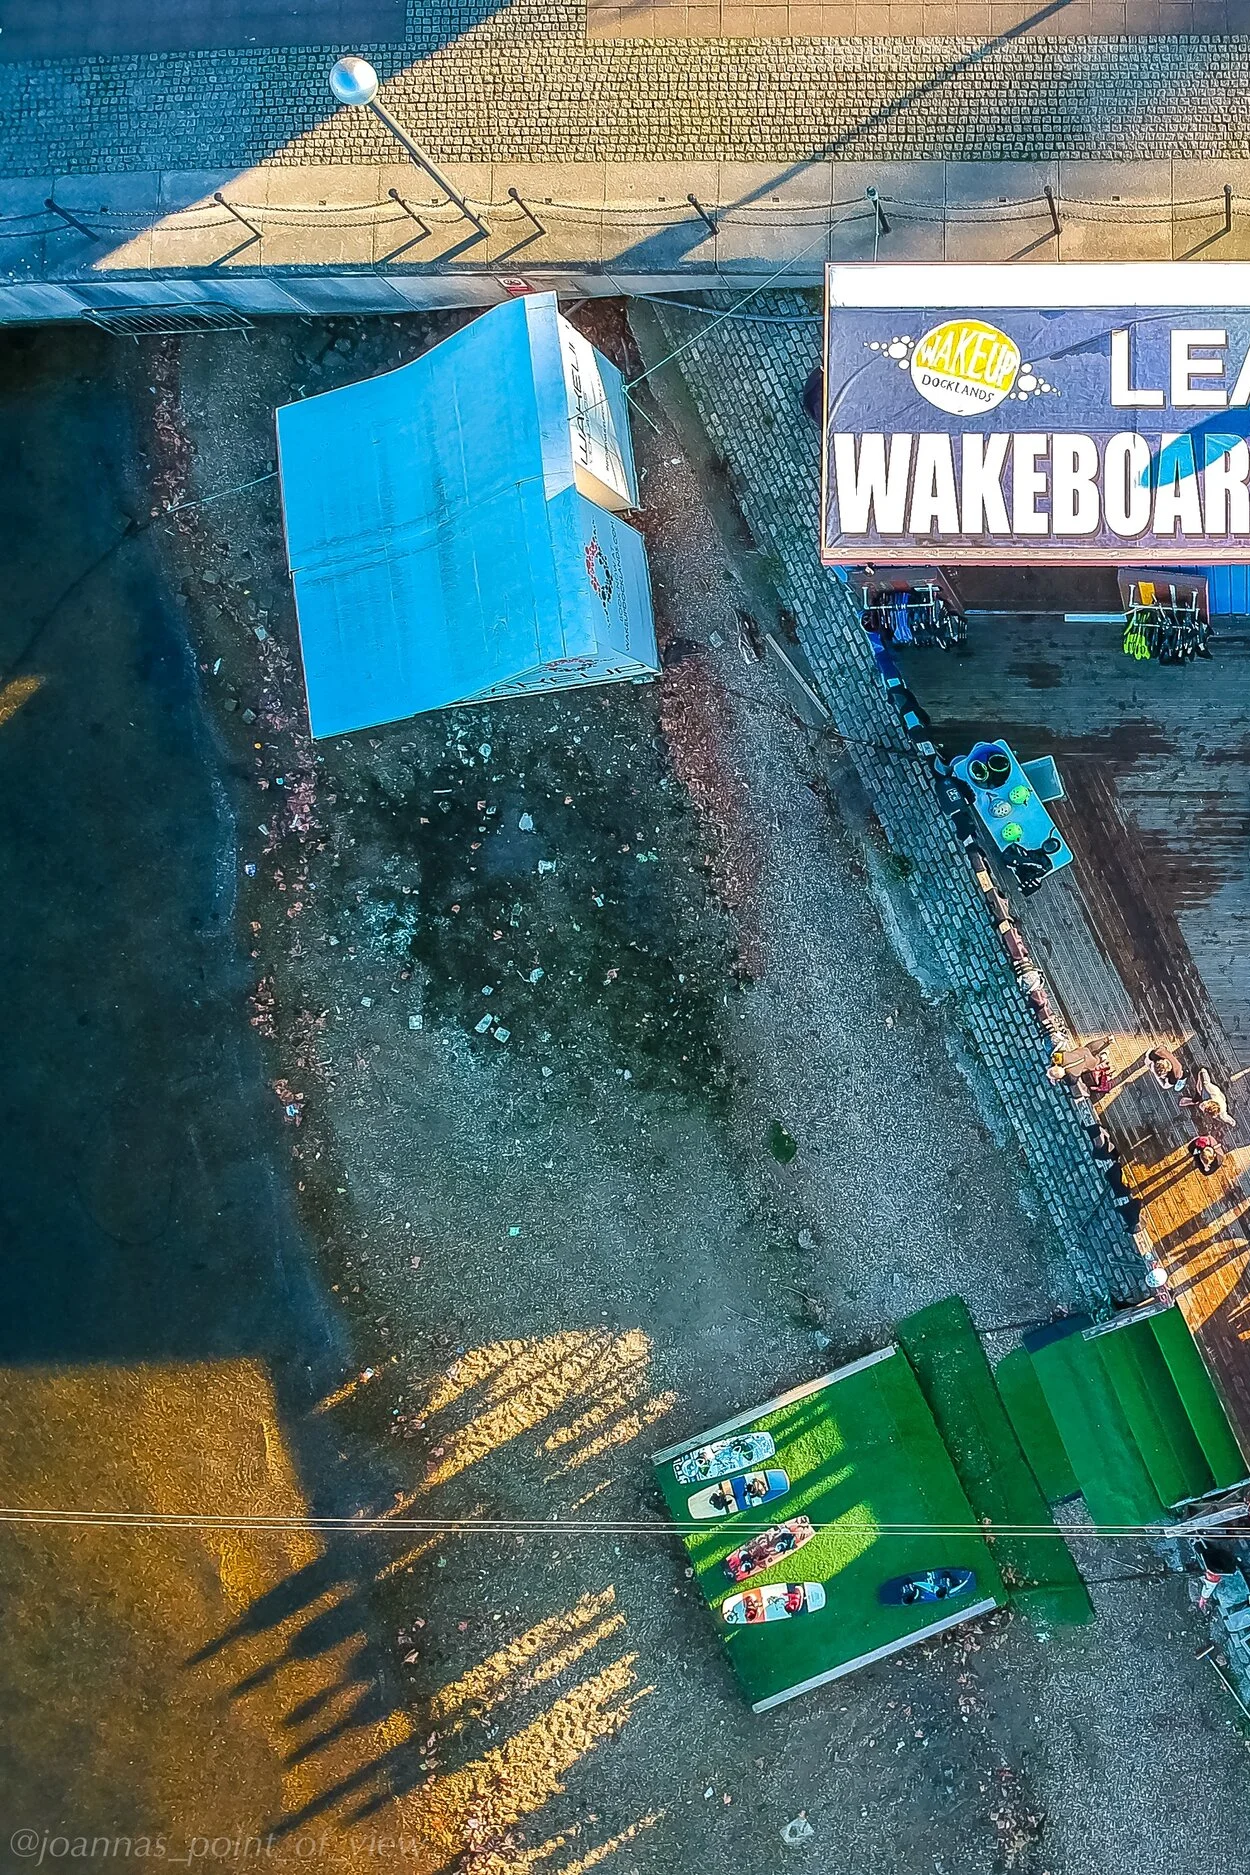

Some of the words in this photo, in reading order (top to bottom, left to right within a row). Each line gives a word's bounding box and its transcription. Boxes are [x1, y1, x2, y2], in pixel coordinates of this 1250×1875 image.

[920, 327, 1016, 388] WAKEUP
[921, 374, 995, 403] DOCKLANDS
[488, 663, 646, 694] AKEUP
